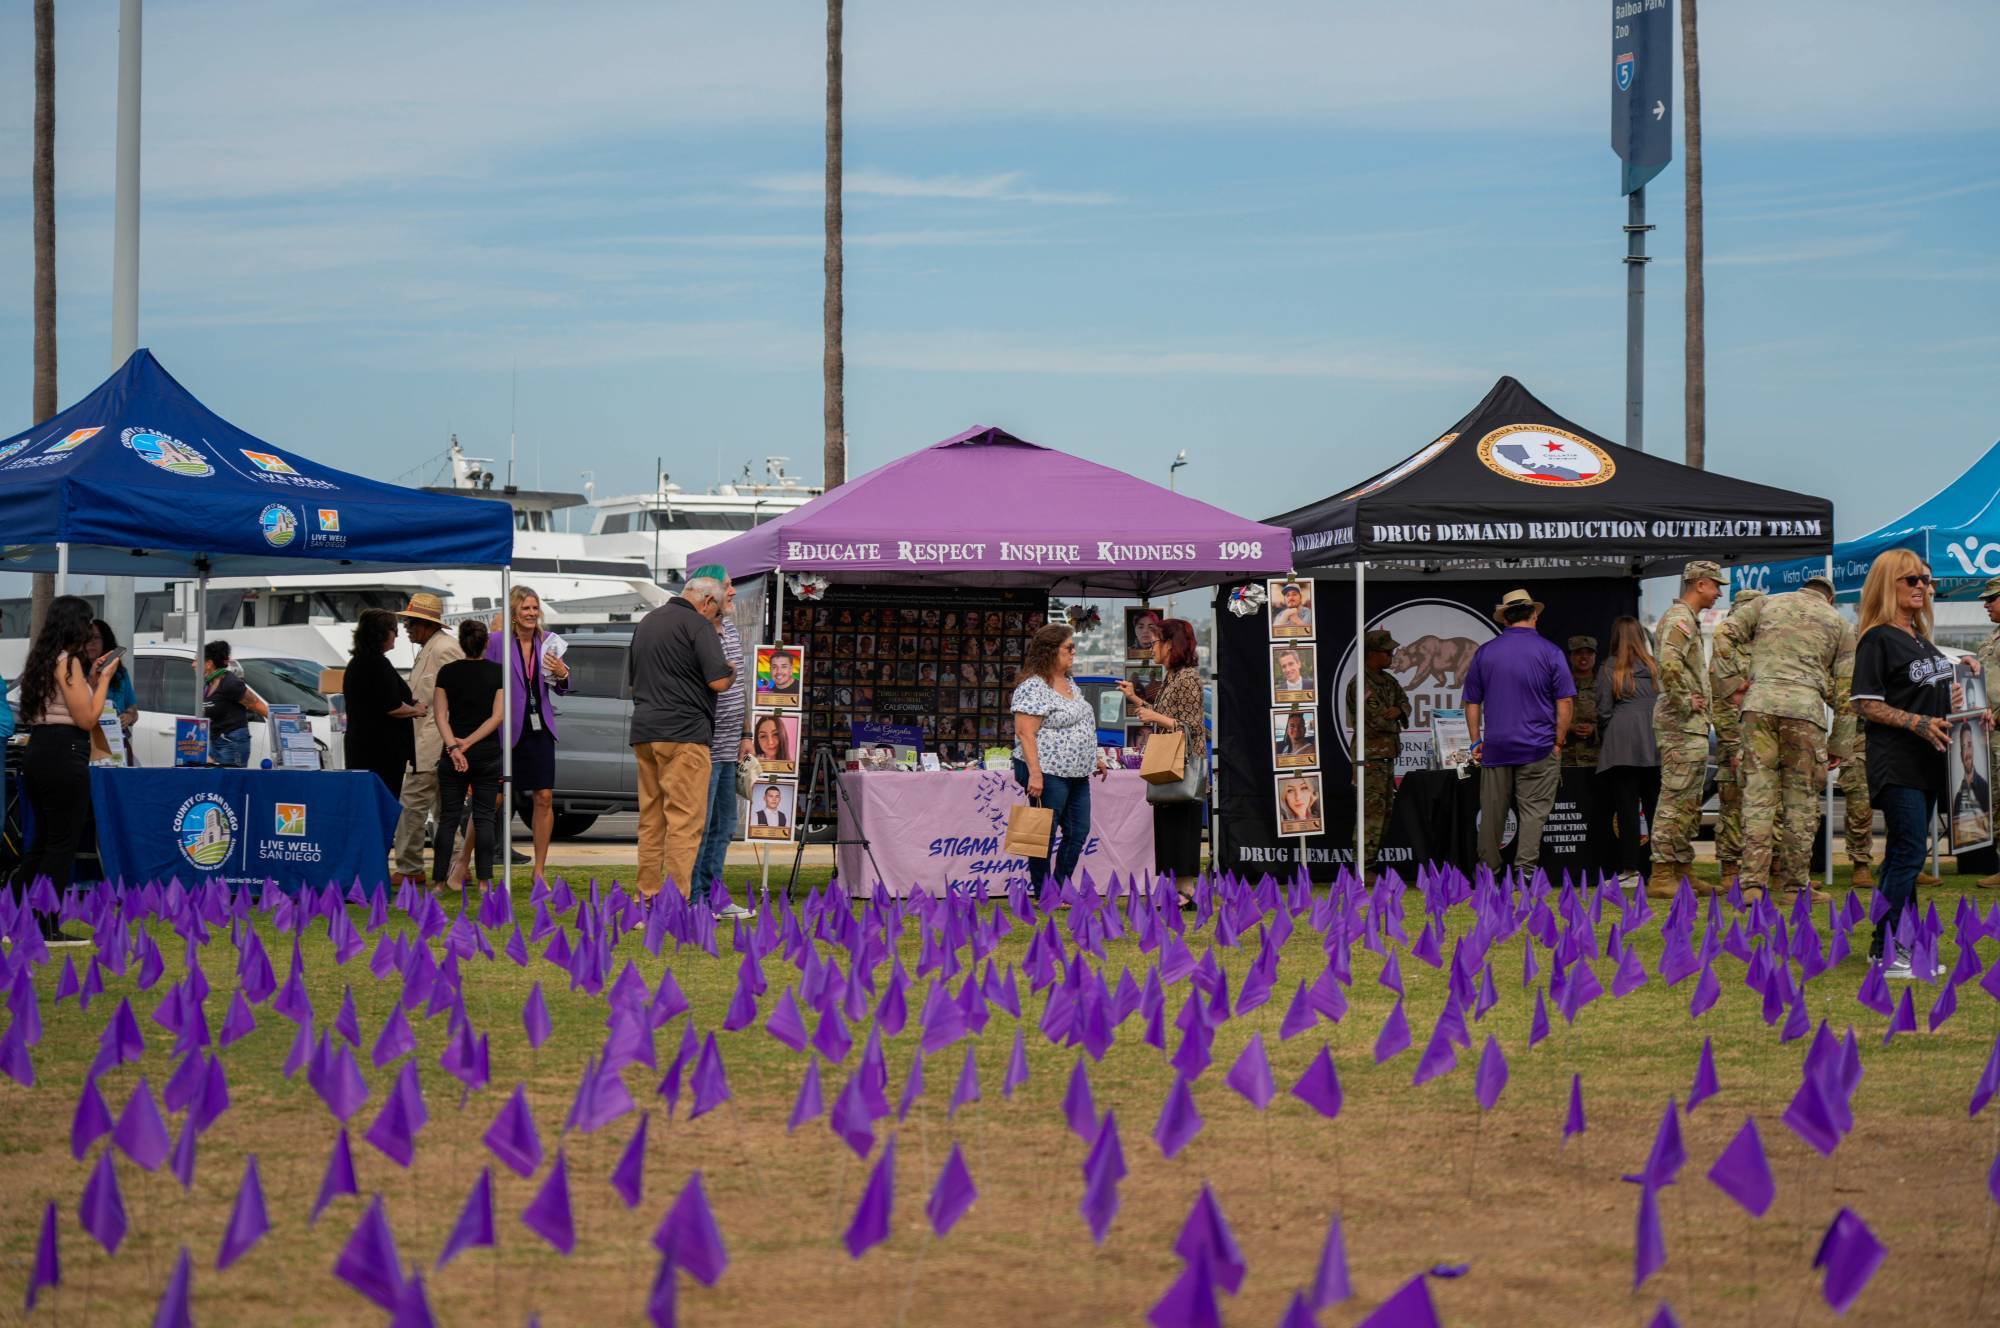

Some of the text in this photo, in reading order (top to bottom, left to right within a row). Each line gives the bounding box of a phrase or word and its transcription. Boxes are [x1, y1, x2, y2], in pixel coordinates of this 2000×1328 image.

[1615, 1, 1642, 19] Balboa
[1615, 25, 1630, 39] Zoo
[1621, 65, 1628, 84] 5
[1513, 425, 1569, 439] NATIONAL
[1572, 436, 1604, 456] GUARD
[311, 533, 347, 543] LIVE WELL
[1372, 519, 1822, 542] DRUG DEMAND REDUCTION OUTREACH TEAM
[787, 541, 881, 561] EDUCATE
[897, 541, 986, 564] RESPECT
[1000, 541, 1080, 565] INSPIRE
[1097, 541, 1196, 565] KINDNESS
[1218, 541, 1263, 560] 1998
[1783, 570, 1801, 583] Vista
[1847, 560, 1869, 577] Clinic
[173, 792, 239, 832] COUNTY OF SAN DIEGO
[1555, 802, 1576, 810] DRUG
[1549, 813, 1582, 821] DEMAND
[260, 839, 322, 853] LIVE WELL
[929, 836, 999, 857] STIGMA
[1543, 834, 1586, 843] OUTREACH
[259, 849, 321, 862] SAN DIEGO
[1239, 846, 1354, 863] DRUG EMAN
[1553, 845, 1576, 853] TEAM
[969, 859, 1030, 875] SHAM
